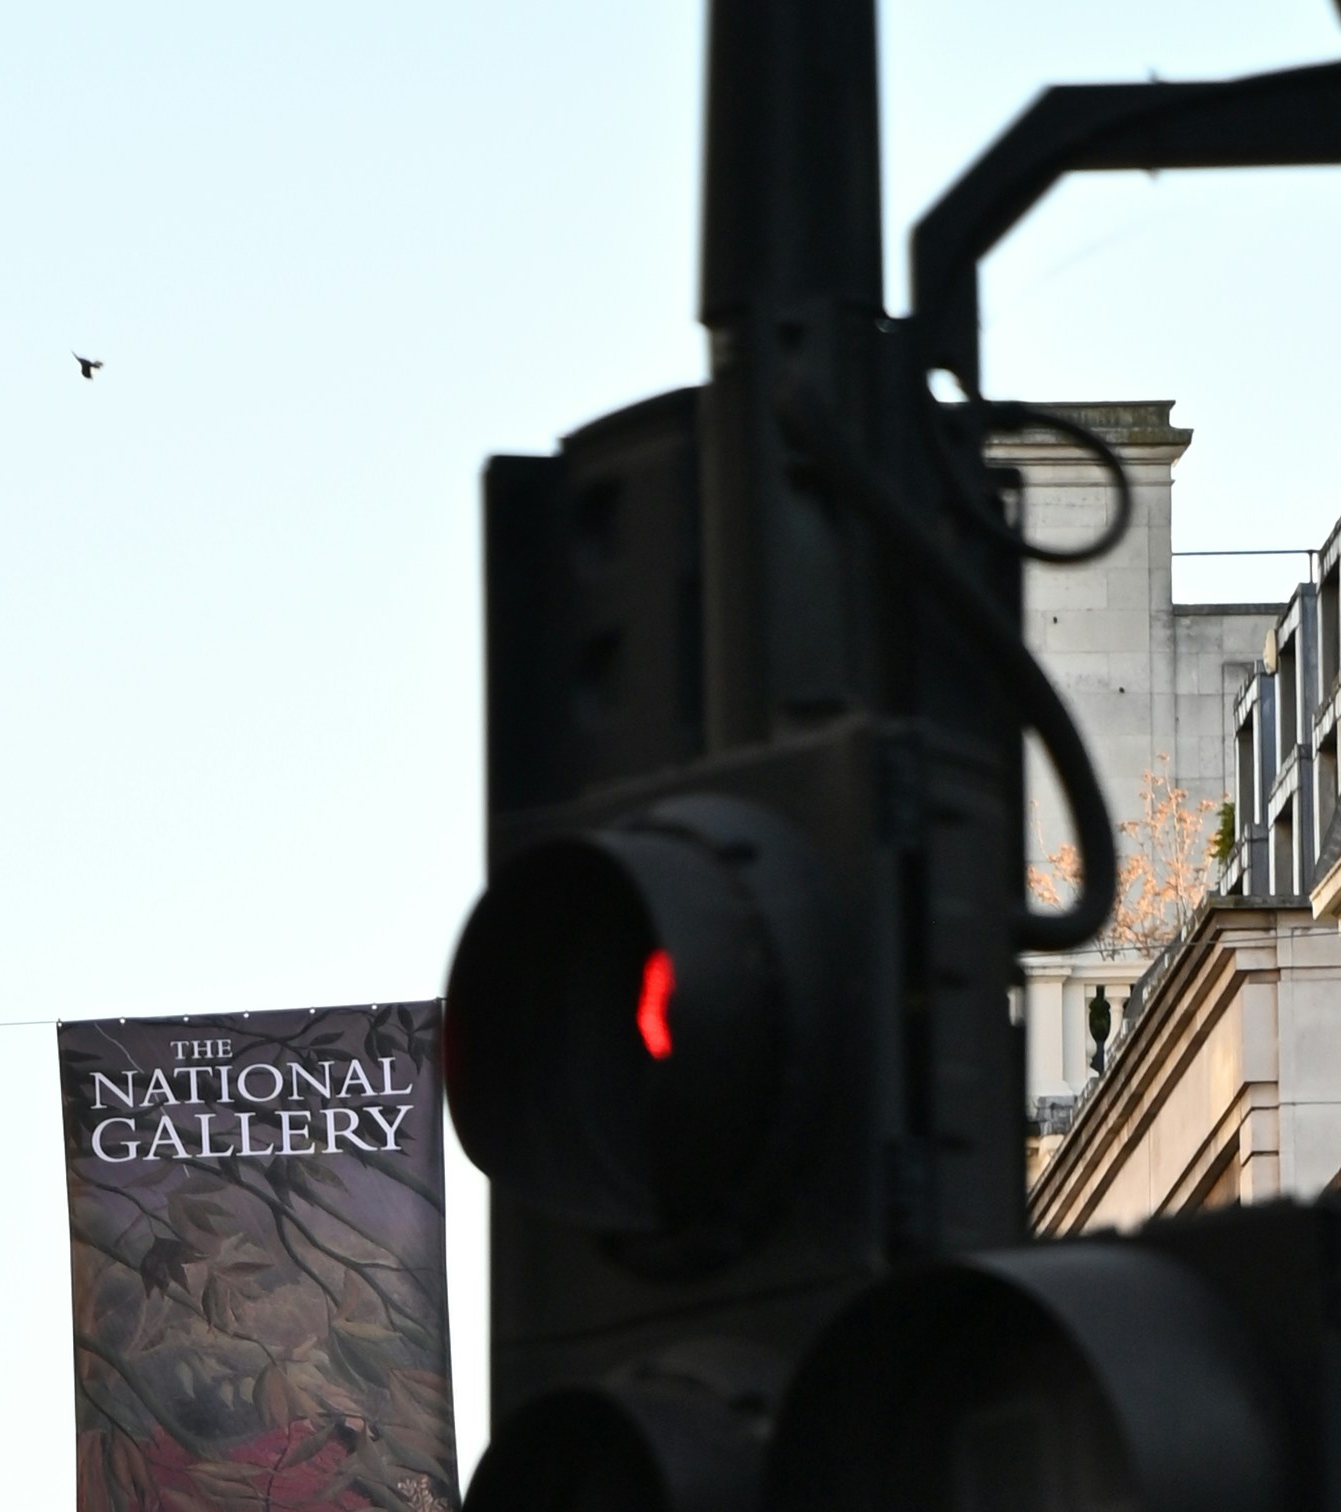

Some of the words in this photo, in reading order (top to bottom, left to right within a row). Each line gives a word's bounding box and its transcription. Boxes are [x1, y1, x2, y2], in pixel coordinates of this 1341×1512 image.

[171, 1039, 233, 1060] THE
[90, 1057, 413, 1111] NATIONAL
[91, 1105, 414, 1164] GALLERY
